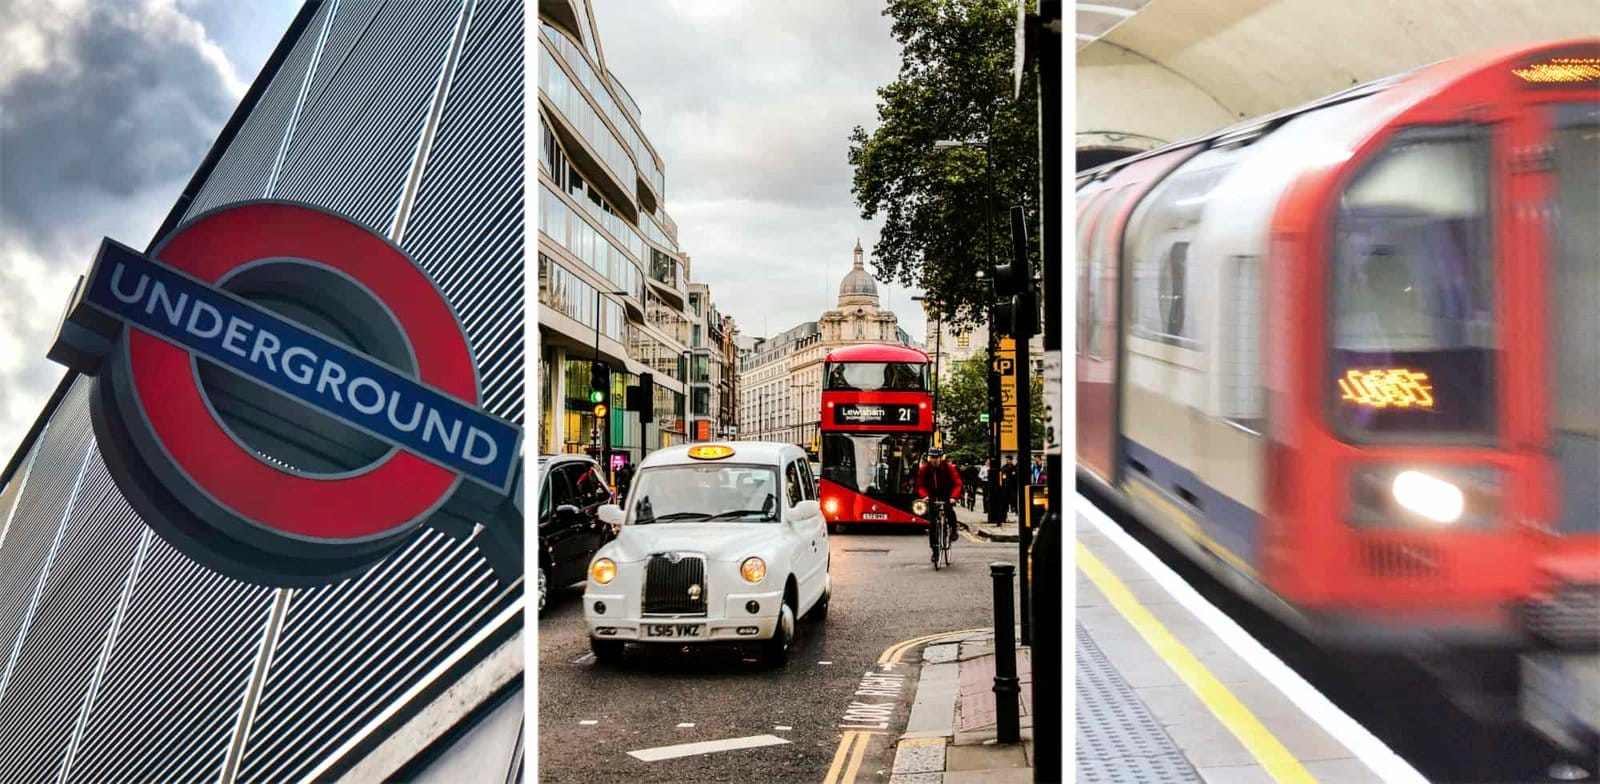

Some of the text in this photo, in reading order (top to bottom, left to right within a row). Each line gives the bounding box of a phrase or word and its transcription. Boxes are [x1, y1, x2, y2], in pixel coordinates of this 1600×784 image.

[109, 263, 499, 467] UNDERGROUND
[842, 406, 911, 421] Lewisham 21
[647, 624, 700, 637] LS15 VMZ
[838, 671, 905, 729] LOOK RIGHT
